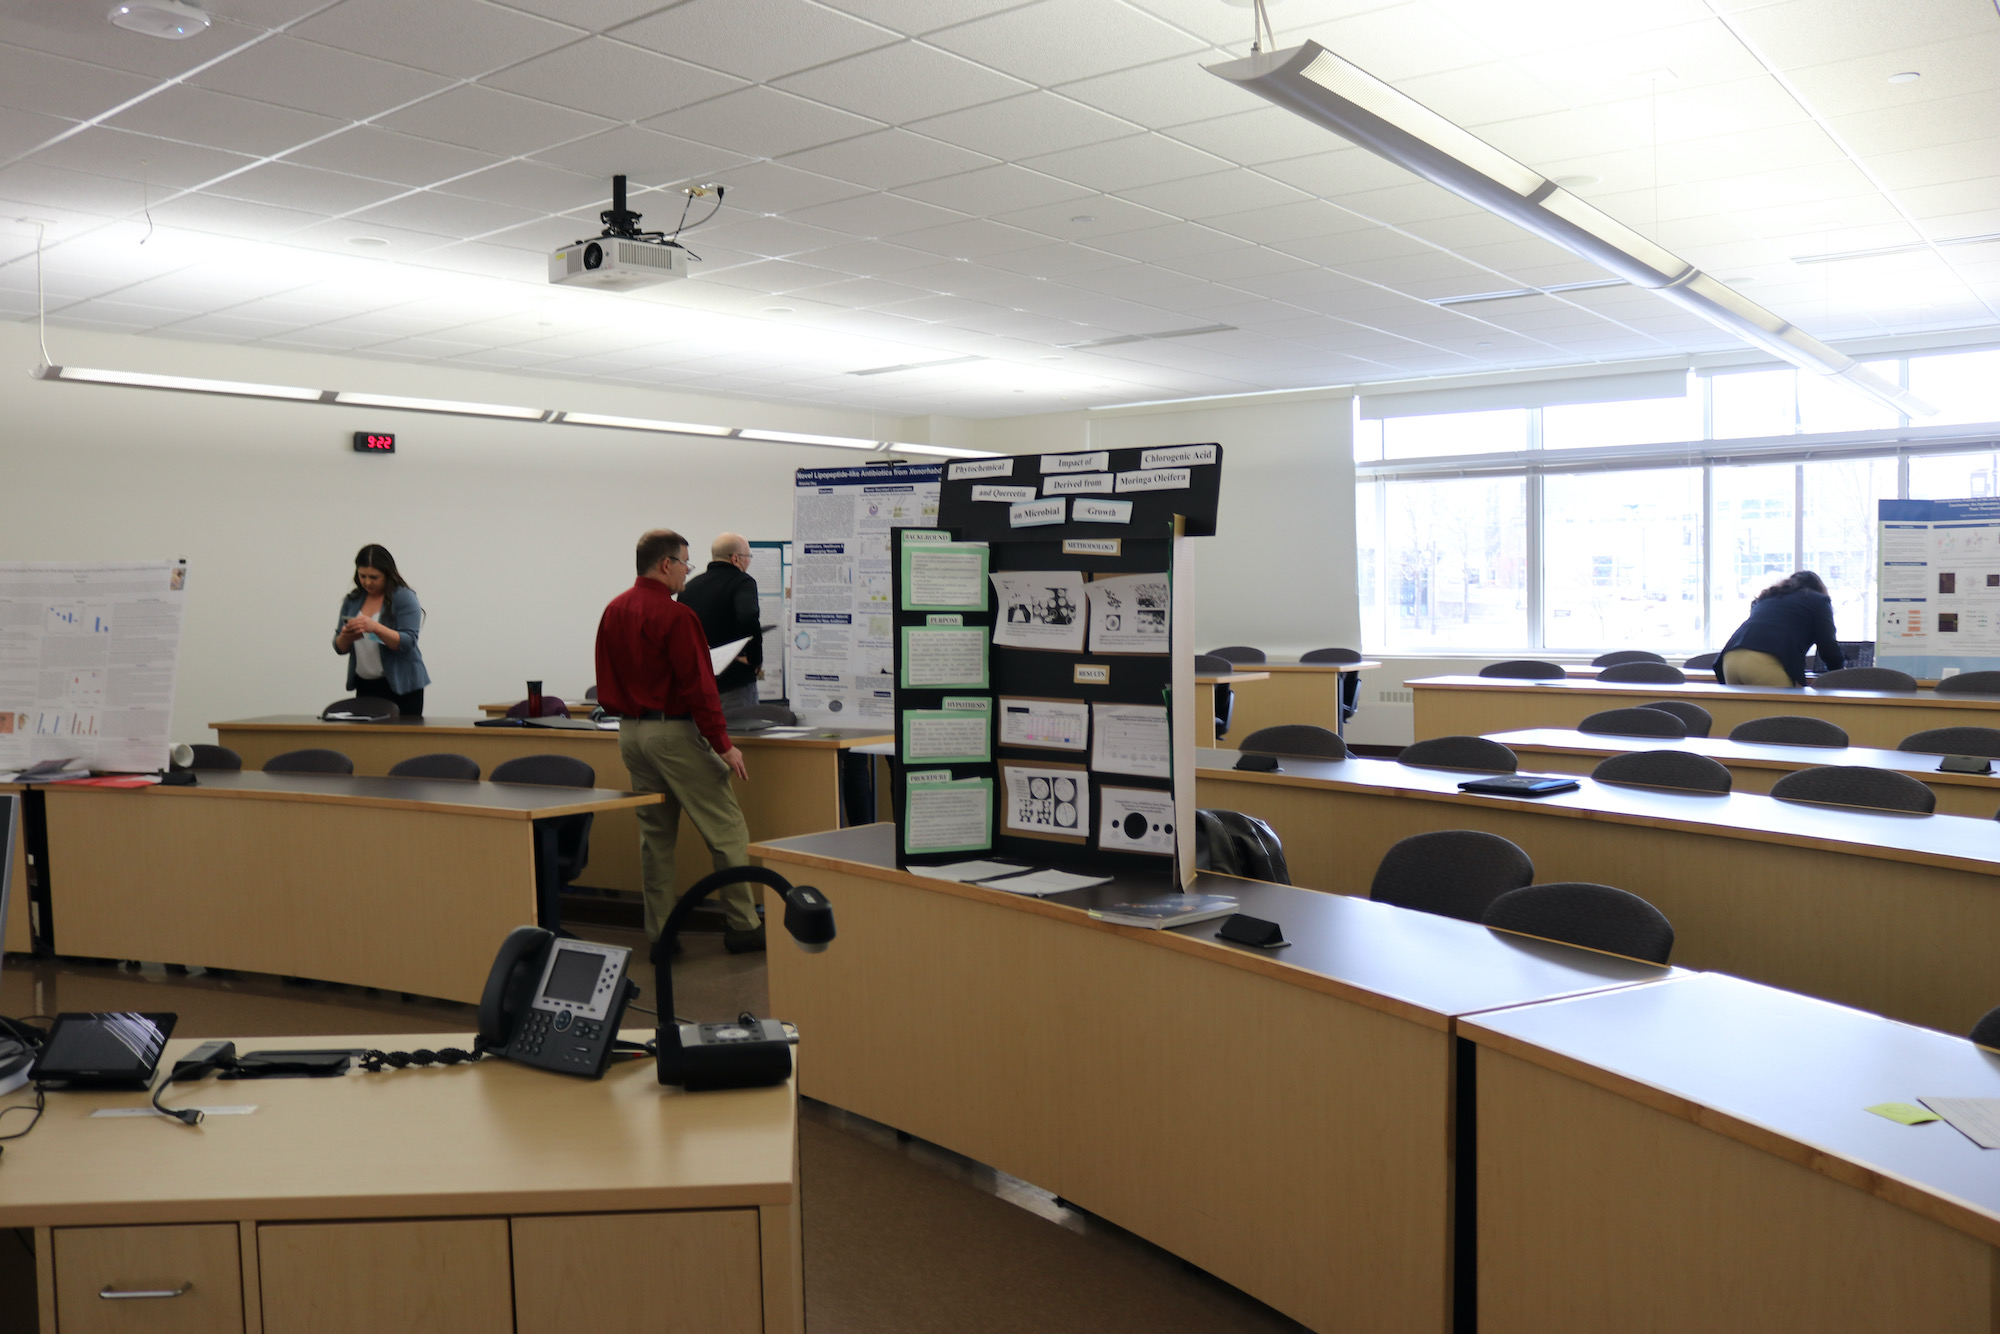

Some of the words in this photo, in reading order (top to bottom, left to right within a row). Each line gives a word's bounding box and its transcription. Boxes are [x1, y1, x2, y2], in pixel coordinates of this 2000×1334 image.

[368, 435, 392, 449] 9:22
[1058, 459, 1083, 468] Impact
[1084, 457, 1093, 465] of
[1145, 453, 1191, 464] Chlorogenic
[1193, 450, 1212, 459] Acid
[796, 471, 813, 480] Novel
[861, 468, 893, 478] Antibiotics
[894, 467, 908, 476] from
[955, 463, 1005, 474] Phytochemical
[1054, 480, 1082, 489] Derived
[1084, 479, 1102, 487] from
[1120, 476, 1152, 486] Moringa
[1154, 473, 1186, 483] Oleifera
[993, 489, 1026, 498] Quercetin
[1024, 507, 1060, 518] Microbial
[1087, 506, 1116, 517] Growth
[1067, 541, 1115, 550] METHODOLOGY
[1078, 669, 1105, 677] RESULTS
[910, 774, 947, 782] PROCEDURE
